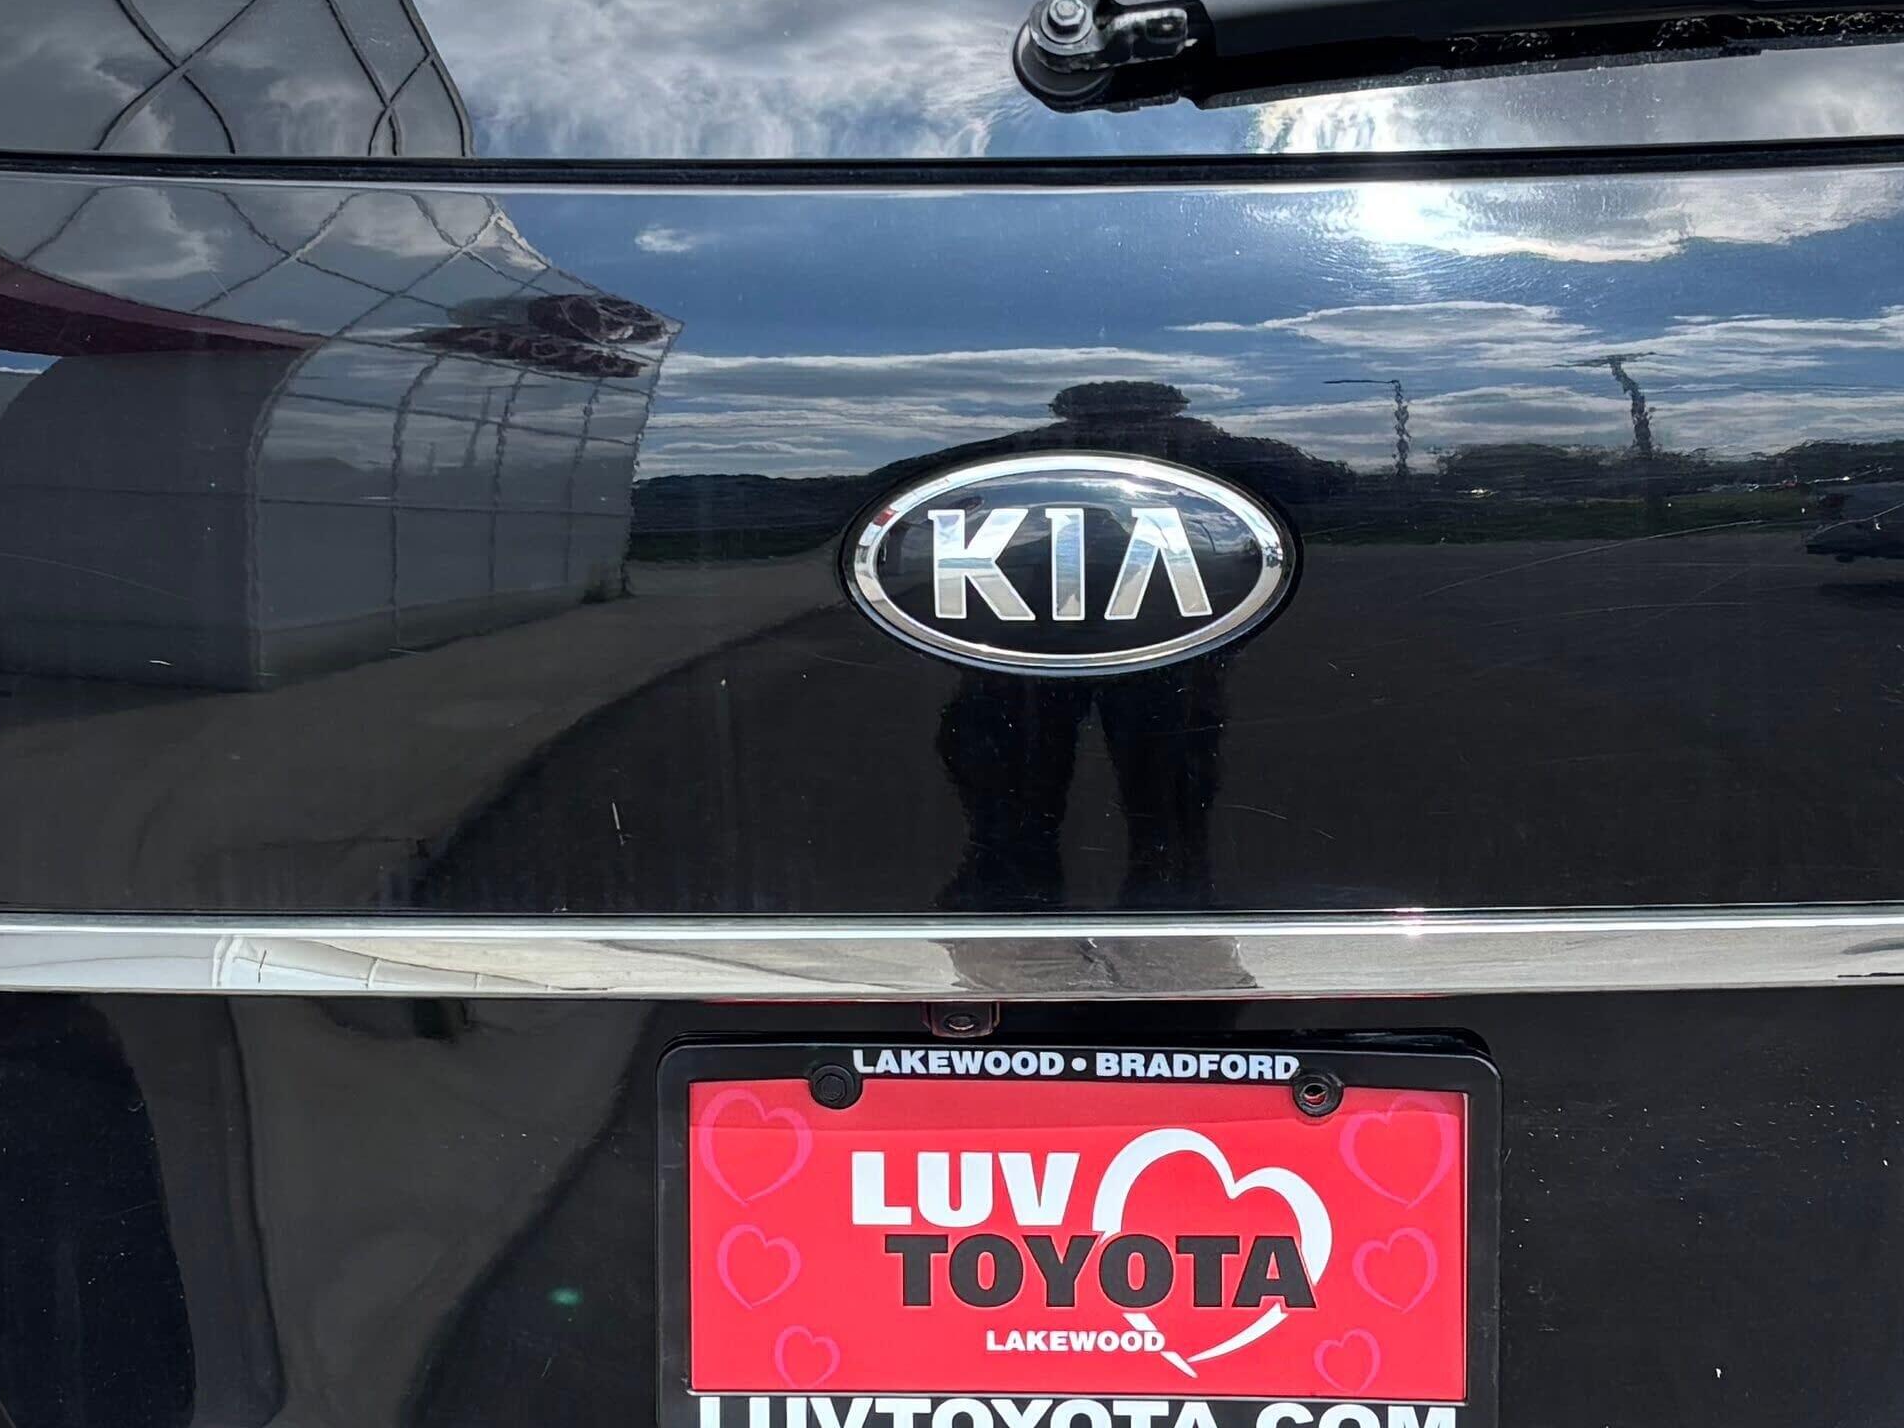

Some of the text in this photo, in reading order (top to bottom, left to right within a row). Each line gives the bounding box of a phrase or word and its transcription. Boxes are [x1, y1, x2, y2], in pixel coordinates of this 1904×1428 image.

[927, 507, 1214, 622] KIA
[852, 1048, 1300, 1081] LAKEWOOD BRADFORD
[851, 1151, 1080, 1227] LUV
[884, 1233, 1316, 1309] TOYOTA
[985, 1329, 1167, 1354] LAKEWOOD
